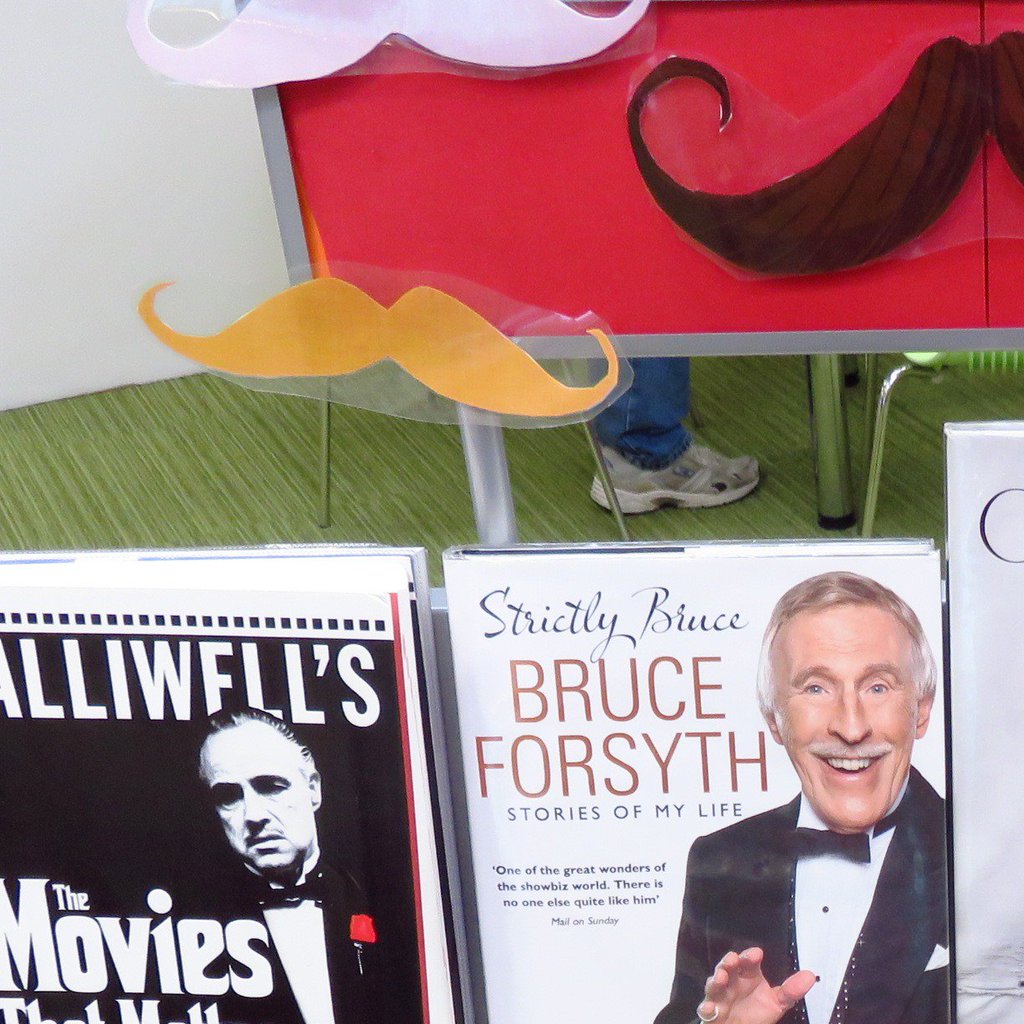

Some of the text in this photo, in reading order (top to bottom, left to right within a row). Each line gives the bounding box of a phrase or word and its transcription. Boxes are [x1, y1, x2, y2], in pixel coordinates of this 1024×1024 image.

[480, 587, 749, 663] Strictly Bruce
[510, 656, 726, 723] BRUCE
[475, 731, 768, 798] FORSYTH
[507, 803, 743, 821] STORIES OF MY LIFE
[525, 865, 537, 875] of
[540, 865, 560, 875] the
[564, 865, 595, 878] great
[599, 863, 650, 874] wonders
[654, 862, 666, 873] of
[498, 879, 663, 892] the showbiz world. There is
[52, 884, 90, 911] The
[503, 899, 518, 908] no
[522, 899, 544, 908] one
[547, 897, 571, 907] else
[574, 896, 604, 909] quite
[608, 895, 630, 906] like
[551, 916, 619, 928] Mail on Sunday
[0, 878, 274, 998] Movies
